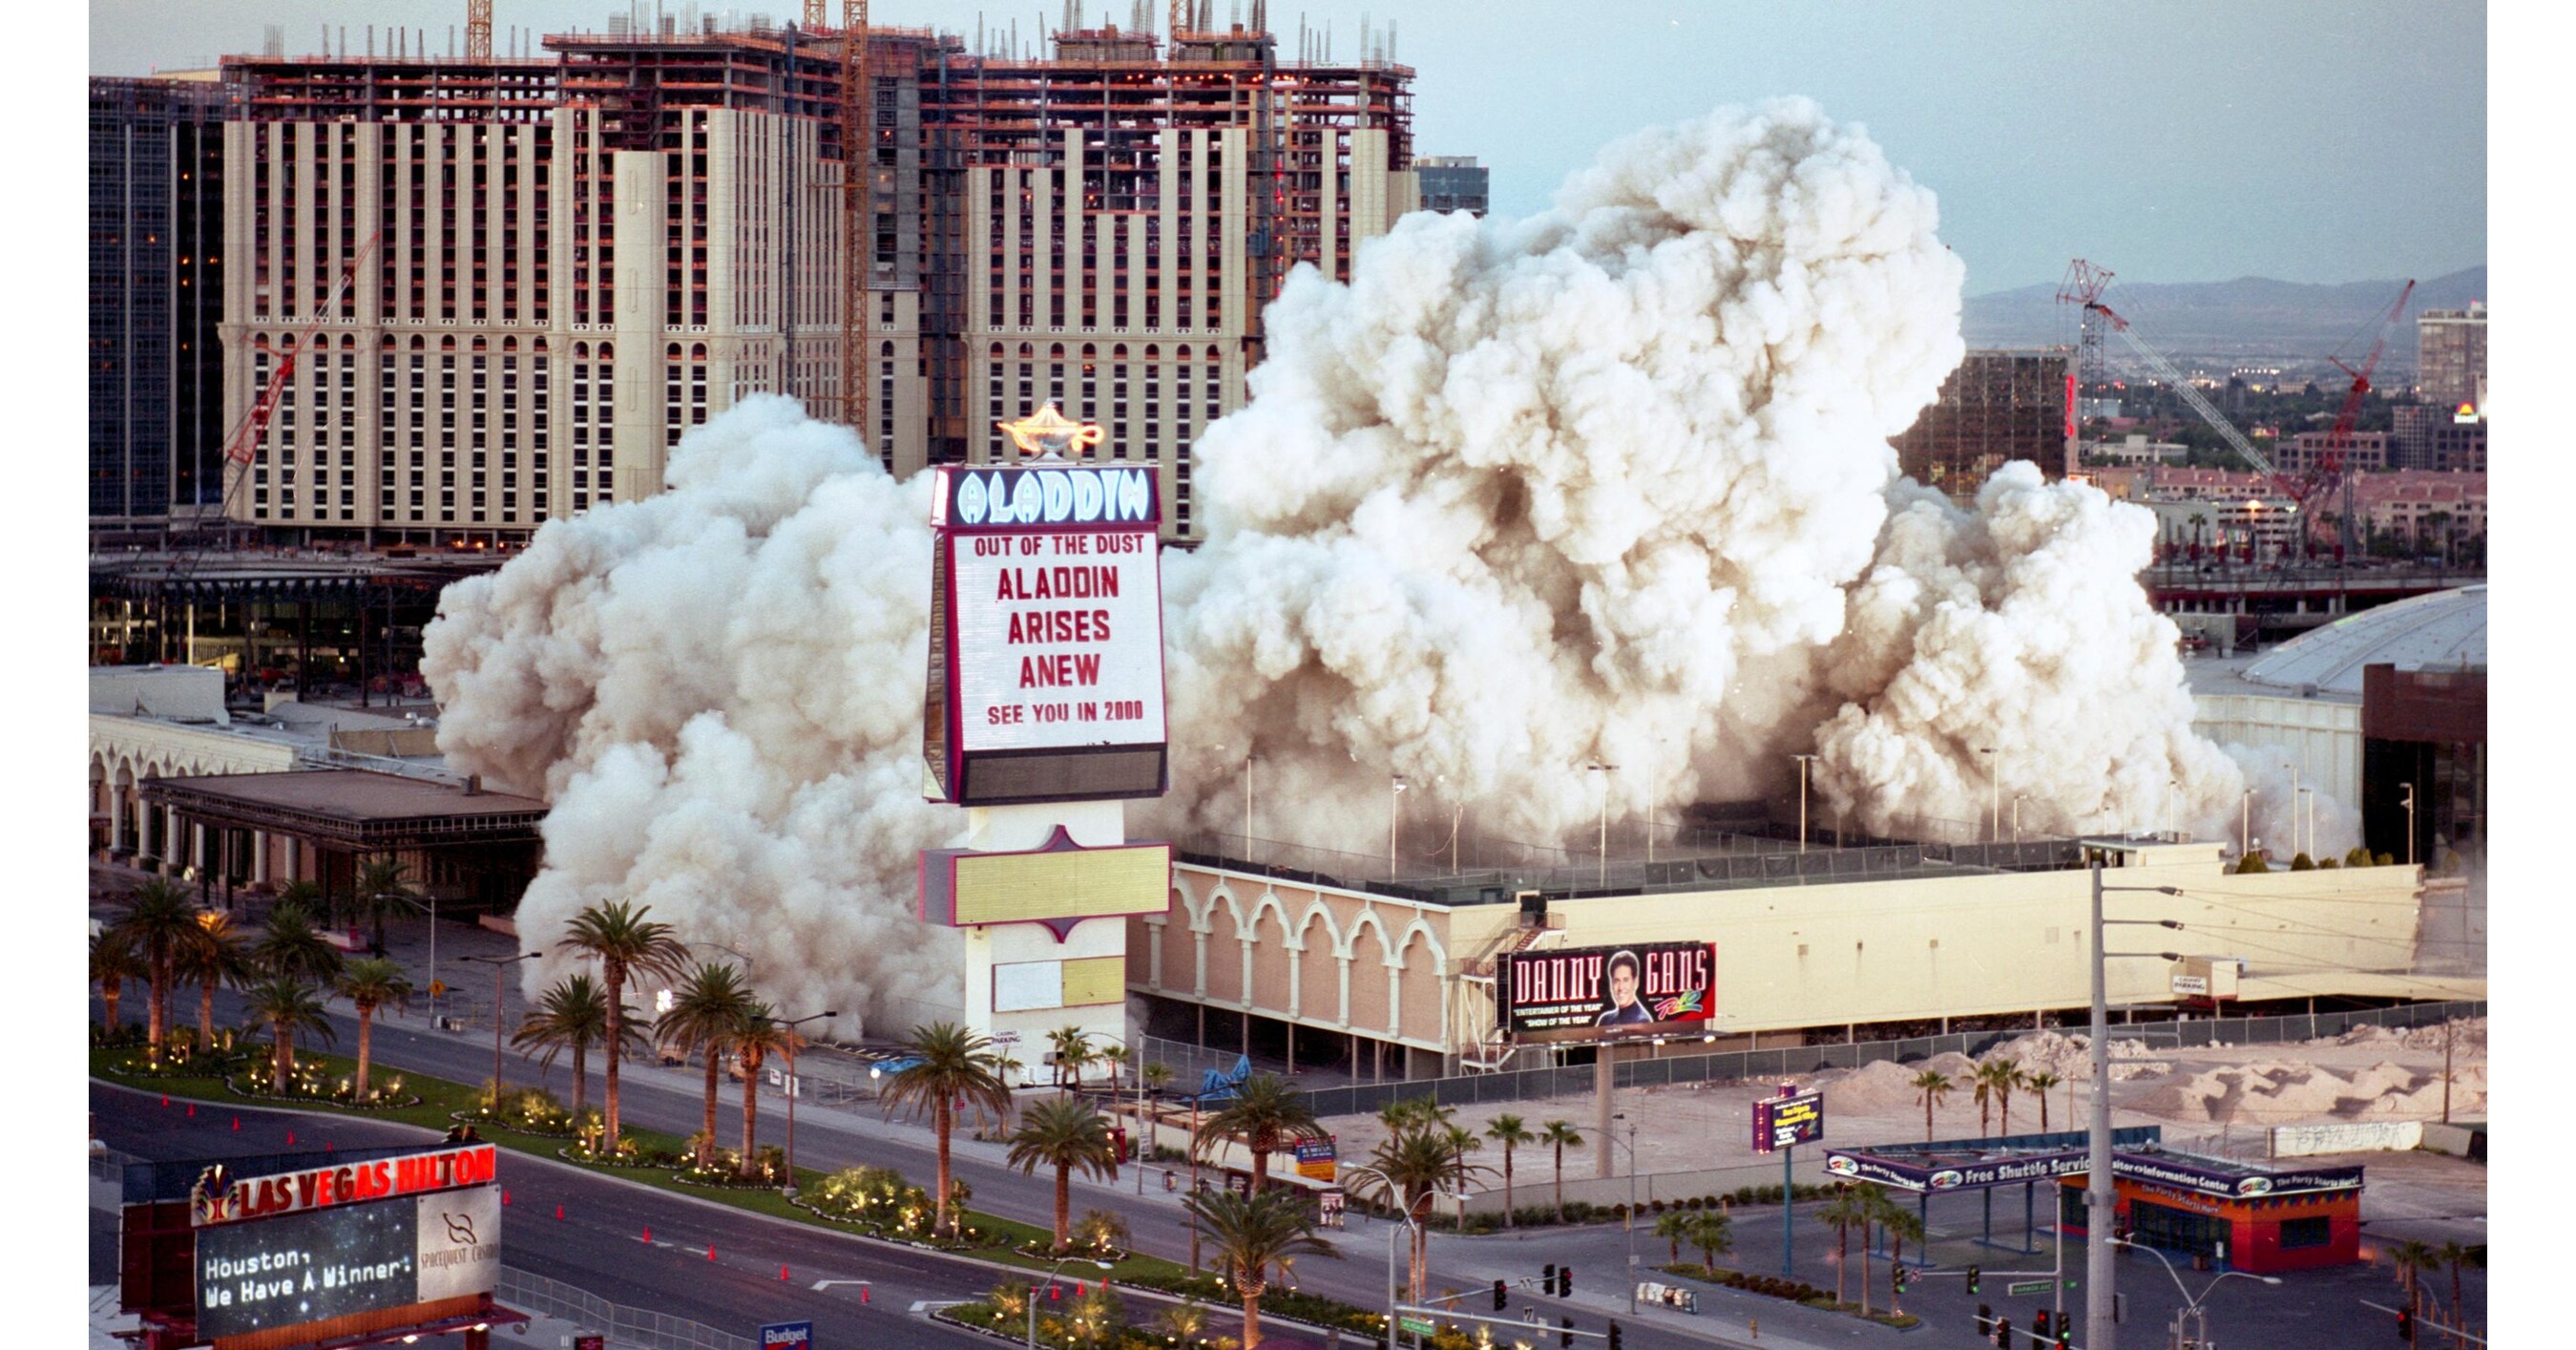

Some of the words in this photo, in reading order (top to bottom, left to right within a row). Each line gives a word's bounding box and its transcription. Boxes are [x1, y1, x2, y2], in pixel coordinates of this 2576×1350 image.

[957, 469, 1149, 523] ALADDIN
[974, 538, 1013, 557] OUT
[1020, 537, 1043, 556] OF
[1054, 536, 1088, 555] THE
[1098, 534, 1144, 554] DUST
[997, 565, 1120, 600] ALADDIN
[1008, 609, 1110, 644] ARISES
[1019, 653, 1100, 688] ANEW
[988, 705, 1023, 725] SEE
[1032, 703, 1069, 723] YOU
[1078, 702, 1097, 721] IN
[1104, 701, 1143, 720] 2000
[1516, 956, 1603, 1003] DANNY
[1646, 949, 1707, 995] GANS
[1559, 1017, 1572, 1025] THE
[1560, 1005, 1569, 1014] OF
[1570, 1003, 1583, 1013] THE
[241, 1176, 293, 1217] LAS
[298, 1161, 391, 1208] VEGAS
[396, 1147, 495, 1192] HILTON
[1965, 1170, 1995, 1184] Free
[1998, 1162, 2048, 1180] Shuttle
[2051, 1156, 2090, 1173] Servic
[2143, 1165, 2198, 1185] Information
[2198, 1176, 2230, 1192] Center
[2276, 1178, 2291, 1187] The
[2292, 1175, 2313, 1185] Party
[205, 1251, 310, 1280] Houston,
[205, 1287, 232, 1308] We
[241, 1279, 293, 1302] Have
[303, 1271, 315, 1290] A
[765, 1328, 807, 1345] Budget
